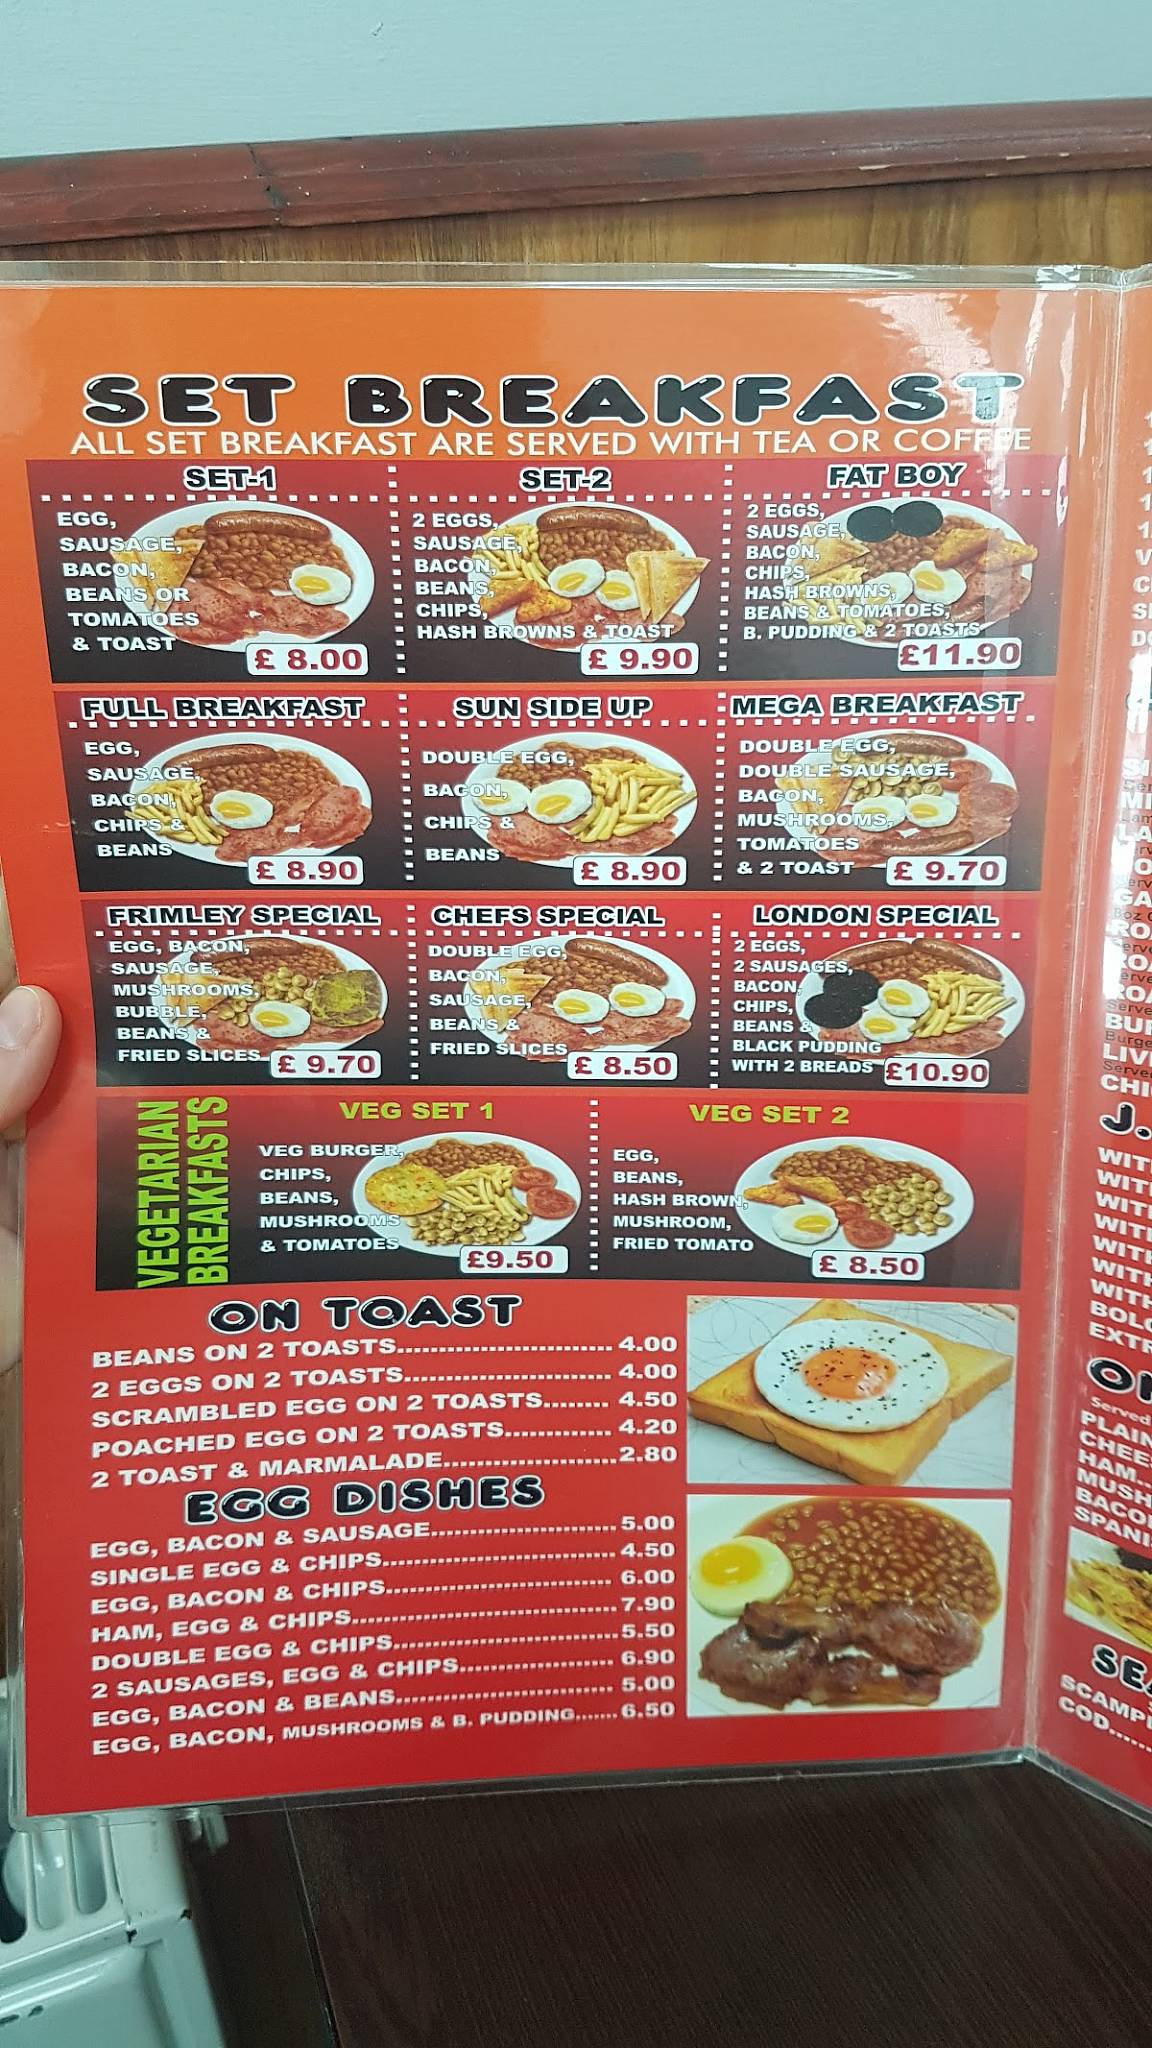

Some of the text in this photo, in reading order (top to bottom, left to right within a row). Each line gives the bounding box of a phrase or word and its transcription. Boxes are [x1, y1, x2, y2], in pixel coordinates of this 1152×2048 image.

[82, 372, 1024, 427] SET BREAKFAST
[70, 427, 1032, 456] ALL SET BREAKFAST ARE SERVED WITH TEA OR COFFEE
[183, 466, 277, 491] SET-1
[520, 467, 612, 492] SET-2
[827, 462, 968, 488] FAT BOY
[746, 503, 825, 520] 2 EGGS,
[57, 512, 116, 529] EGG,
[412, 513, 499, 530] 2 EGGS,
[746, 523, 846, 540] SAUSAGE,
[59, 537, 183, 555] SAUSAGE,
[413, 536, 523, 553] SAUSAGE,
[746, 545, 820, 562] BACON,
[62, 563, 155, 580] BACON,
[414, 559, 497, 576] BACON,
[745, 565, 810, 582] CHIPS,
[65, 587, 191, 602] BEANS OR
[415, 581, 495, 597] BEANS,
[745, 584, 896, 601] HASH BROWNS,
[68, 612, 199, 627] TOMATOES
[416, 603, 488, 620] CHIPS,
[744, 603, 950, 620] BEANS & TOMATOES,
[417, 624, 674, 639] HASH BROWNS & TOAST
[255, 648, 363, 671] £ 8.00
[900, 642, 1020, 666] £11.90
[81, 697, 365, 720] FULL BREAKFAST
[453, 697, 653, 720] SUN SIDE UP
[730, 692, 1023, 718] MEGA BREAKFAST
[84, 741, 140, 758] EGG,
[740, 739, 896, 755] DOUBLE EGG,
[422, 751, 575, 767] DOUBLE EGG,
[88, 767, 201, 783] SAUSAGE,
[739, 764, 955, 779] DOUBLE SAUSAGE,
[423, 784, 508, 800] BACON,
[738, 789, 823, 805] BACON,
[91, 794, 176, 810] BACON,
[737, 813, 895, 828] MUSHROOMS,
[98, 844, 173, 857] BEANS
[737, 837, 860, 851] TOMATOES
[425, 848, 500, 862] BEANS
[581, 861, 681, 881] £ 8.90
[107, 905, 381, 926] FRIMLEY SPECIAL
[431, 906, 665, 927] CHEFS SPECIAL
[754, 905, 998, 926] LONDON SPECIAL
[109, 940, 250, 955] EGG, BACON,
[428, 945, 567, 960] DOUBLE EGG,
[734, 940, 806, 955] 2 EGGS,
[111, 963, 219, 977] SAUSAGE,
[428, 970, 507, 985] BACON,
[114, 984, 260, 998] MUSHROOMS,
[734, 981, 803, 996] BACON,
[429, 994, 532, 1009] SAUSAGE,
[733, 1001, 793, 1015] CHIPS,
[115, 1006, 207, 1021] BUBBLE,
[118, 1050, 261, 1062] FRIED SLICES
[430, 1043, 568, 1055] FRIED SLICES
[732, 1041, 882, 1054] BLACK PUDDING
[886, 1062, 989, 1082] £10.90
[338, 1101, 495, 1120] VEG SET 1
[688, 1104, 850, 1125] VEG SET 2
[259, 1144, 405, 1160] VEG BURGER,
[613, 1149, 660, 1165] EGG,
[259, 1168, 331, 1183] CHIPS,
[613, 1171, 684, 1187] BEANS,
[136, 1100, 180, 1288] VEGETARIAN
[186, 1096, 229, 1285] BREAKFASTS
[259, 1191, 340, 1207] BEANS,
[613, 1194, 749, 1210] HASH BROWN,
[259, 1214, 400, 1228] MUSHROOMS
[613, 1216, 731, 1231] MUSHROOM,
[613, 1238, 754, 1251] FRIED TOMATO
[466, 1250, 554, 1269] £9.50
[819, 1256, 919, 1275] £ 8.50
[208, 1295, 522, 1334] ON TOAST
[92, 1391, 678, 1428] SCRAMBLED EGG ON 2 4.50
[1090, 1396, 1150, 1426] Served
[92, 1419, 678, 1458] POACHED EGG ON 2 4.20
[185, 1475, 545, 1525] EGG DISHES
[90, 1542, 675, 1586] SINGLE EGG & 4.50
[91, 1596, 675, 1643] HAM, EGG & 7.90
[91, 1650, 675, 1698] 2 SAUSAGES, EGG & 6.90
[621, 1702, 675, 1718] 6.50
